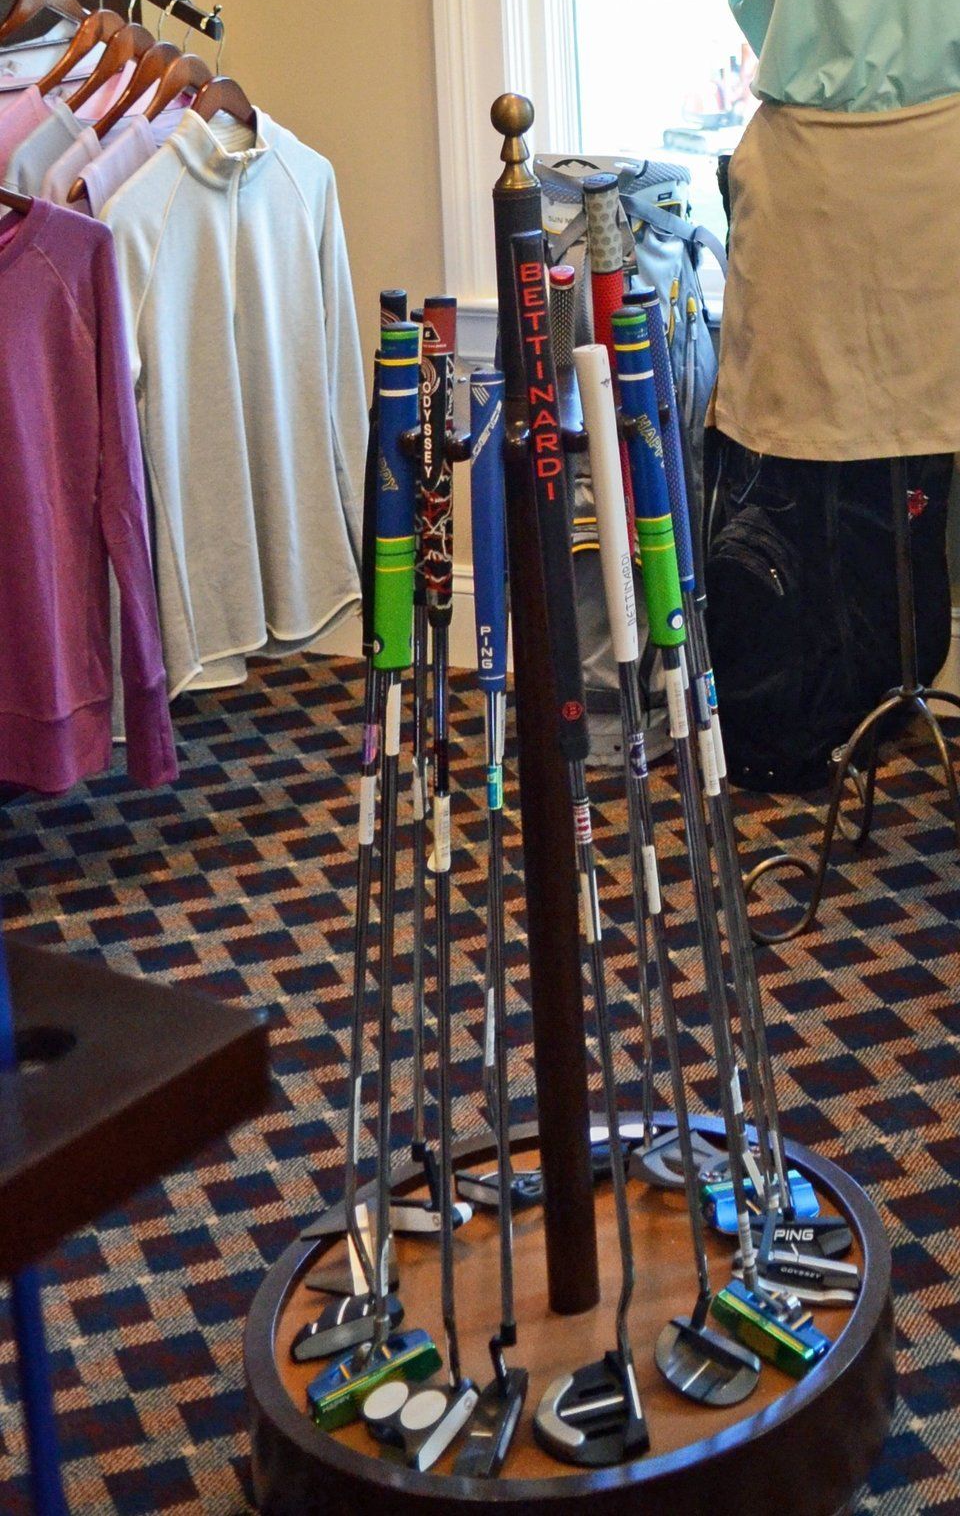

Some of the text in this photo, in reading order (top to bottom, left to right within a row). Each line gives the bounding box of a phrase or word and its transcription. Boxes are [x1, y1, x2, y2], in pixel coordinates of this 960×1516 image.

[519, 262, 563, 501] BETTINARDI
[422, 381, 433, 479] ODYSSEY
[636, 413, 665, 469] HAPP
[480, 625, 493, 669] PING
[773, 1228, 814, 1241] PING
[780, 1266, 822, 1279] ODYSSEY
